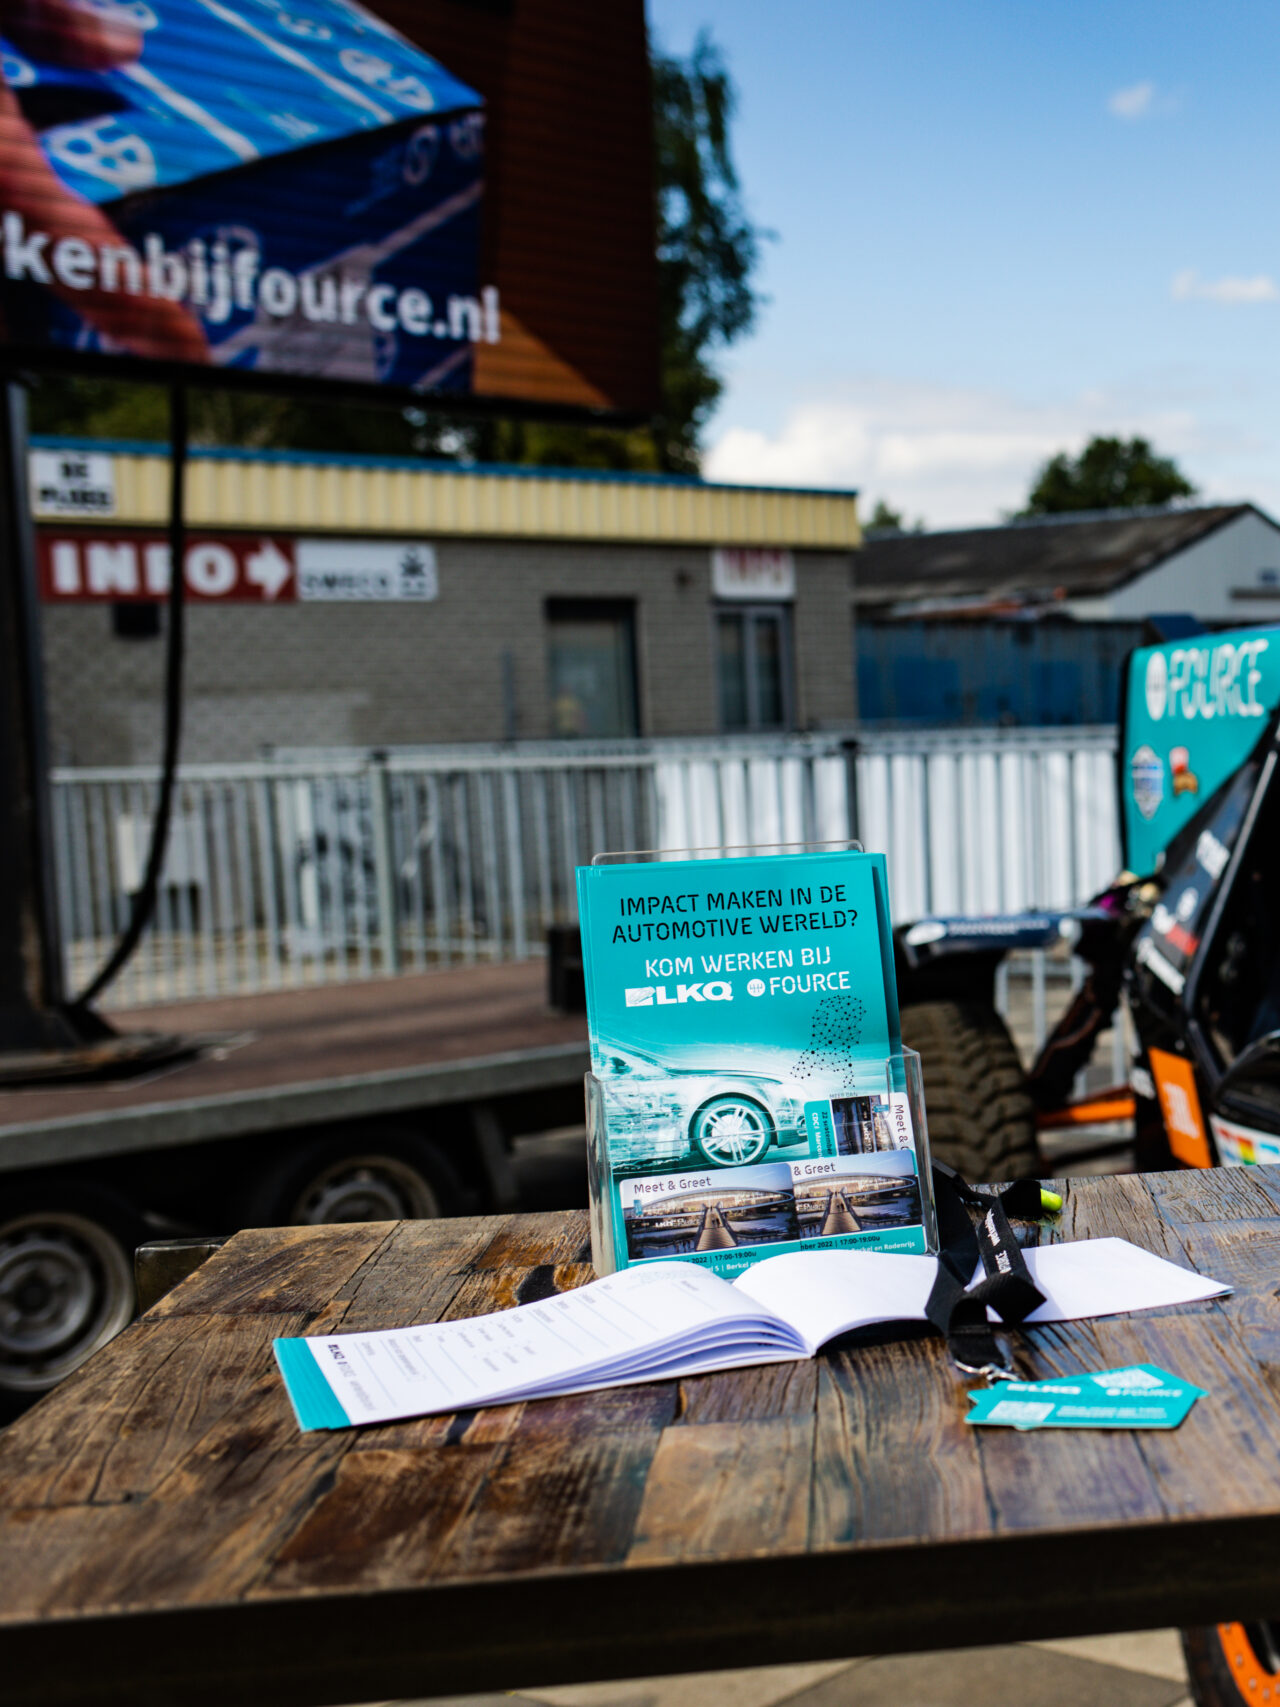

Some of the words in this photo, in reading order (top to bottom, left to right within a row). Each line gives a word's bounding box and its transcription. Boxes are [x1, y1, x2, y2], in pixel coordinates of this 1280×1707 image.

[0, 210, 500, 344] kenbijfource.nl
[51, 540, 238, 597] INFO
[1168, 638, 1269, 719] FOURCE
[620, 894, 700, 917] IMPACT
[707, 888, 783, 911] MAKEN
[790, 887, 812, 906] IN
[820, 884, 848, 903] DE
[612, 917, 753, 944] AUTOMOTIVE
[759, 909, 858, 934] WERELD?
[645, 957, 694, 978] KOM
[701, 950, 793, 974] WERKEN
[801, 946, 832, 966] BIJ
[656, 980, 734, 1005] LKQ
[769, 971, 851, 996] FOURCE
[894, 1104, 907, 1133] Meet
[793, 1166, 801, 1176] &
[804, 1162, 836, 1175] Greet
[634, 1183, 665, 1194] Meet
[668, 1180, 676, 1190] &
[679, 1176, 712, 1189] Greet
[817, 1240, 833, 1249] 2022
[884, 1240, 916, 1250] Rodenrijs
